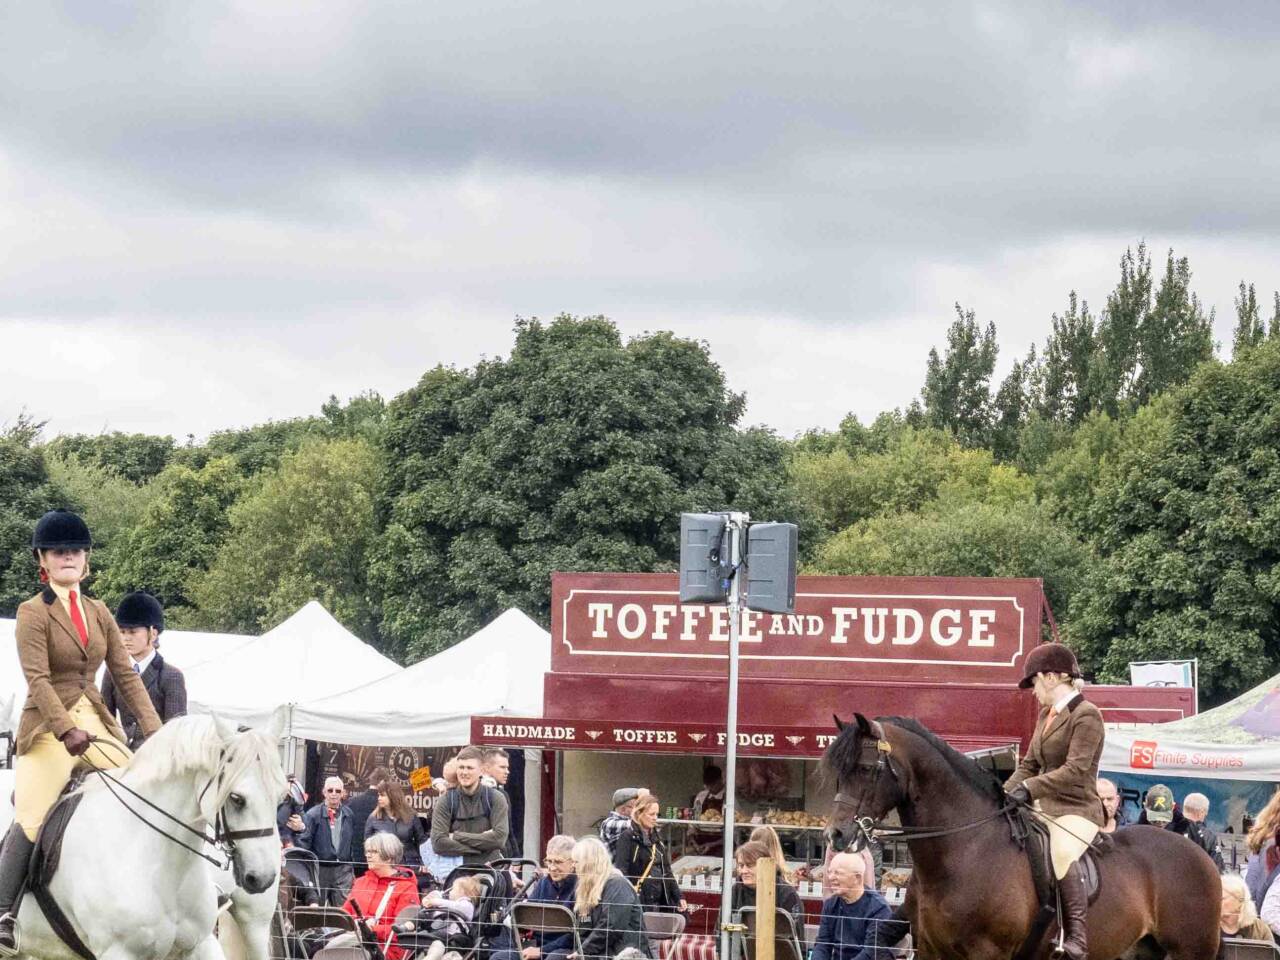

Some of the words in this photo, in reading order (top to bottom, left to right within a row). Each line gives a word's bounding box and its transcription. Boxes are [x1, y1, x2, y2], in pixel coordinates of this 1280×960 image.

[588, 602, 763, 643] TOFFEE
[769, 614, 824, 636] AND
[830, 607, 996, 647] FUDGE
[483, 724, 576, 740] HANDMADE
[613, 729, 677, 744] TOFFEE
[717, 732, 775, 747] FDGE
[1132, 746, 1154, 764] FS
[1155, 752, 1187, 765] Finite
[1191, 753, 1243, 769] Supplies
